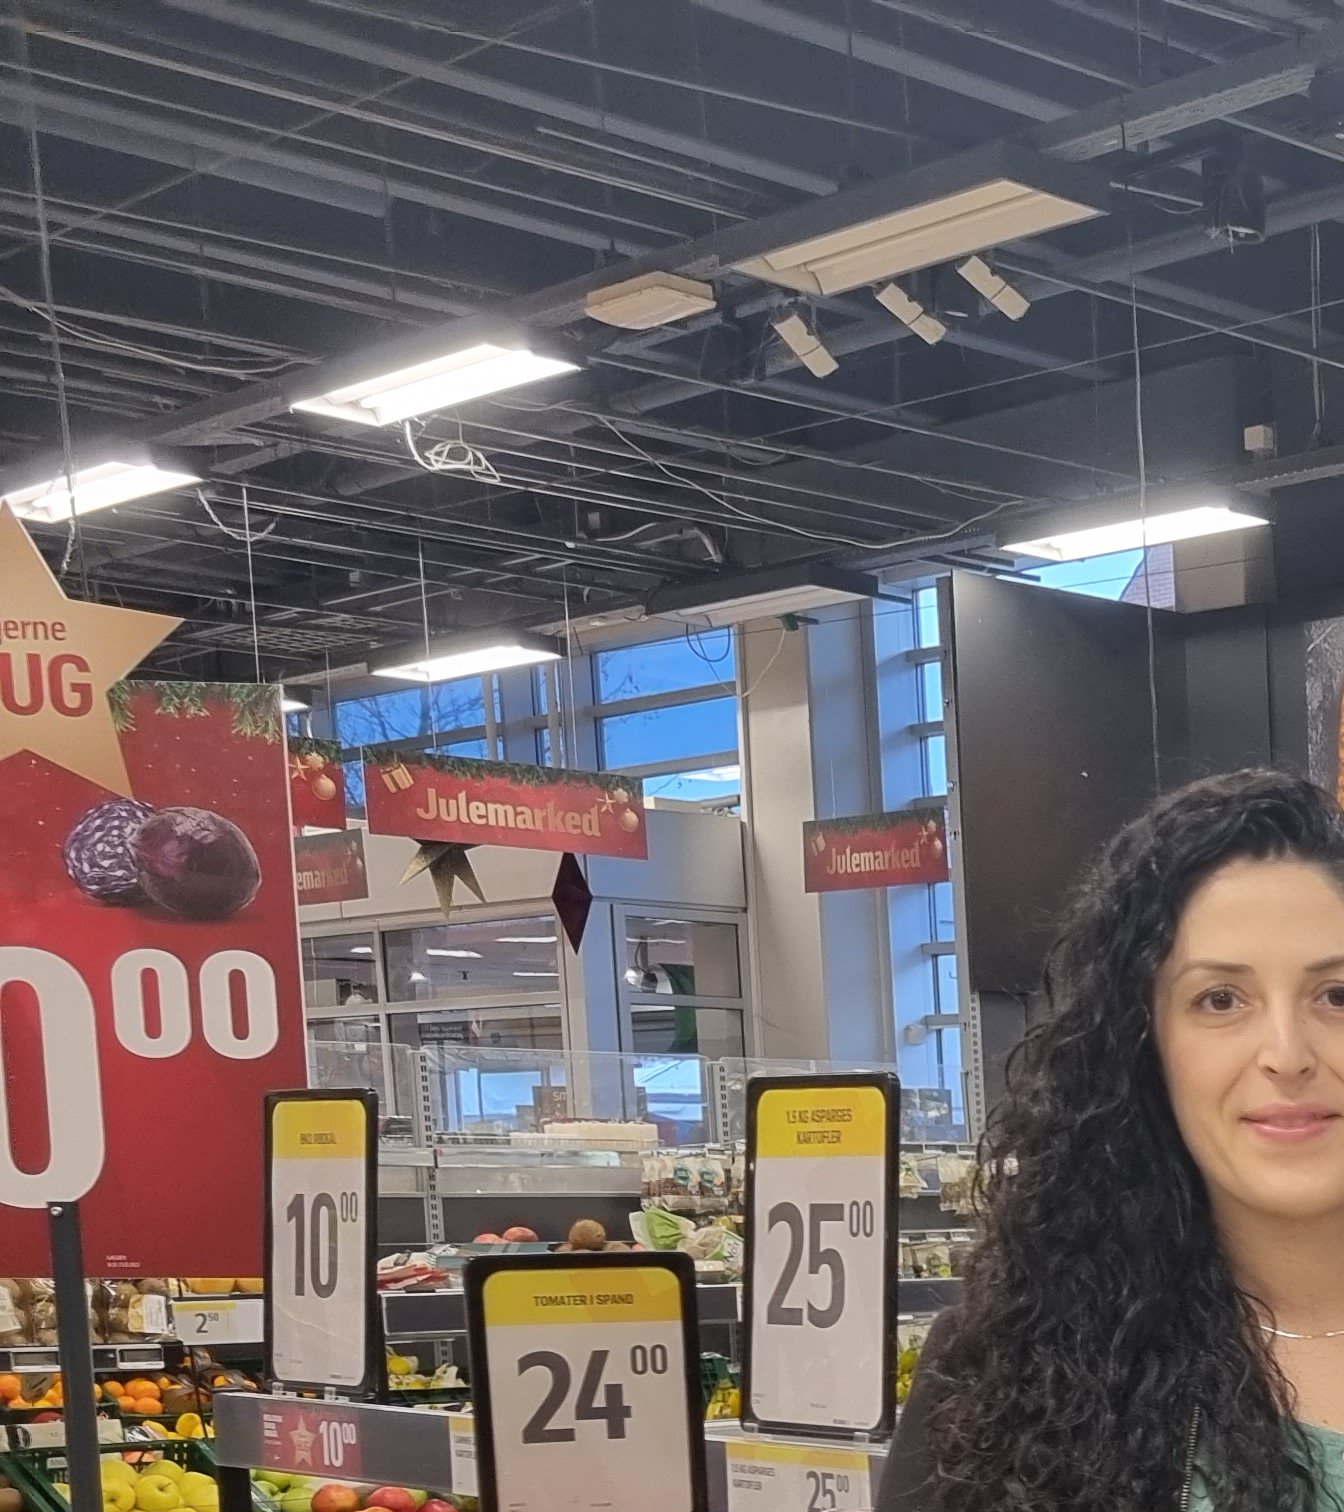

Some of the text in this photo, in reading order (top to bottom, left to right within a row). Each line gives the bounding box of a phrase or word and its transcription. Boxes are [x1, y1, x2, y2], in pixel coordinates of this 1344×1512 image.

[415, 787, 601, 838] Julemarked
[826, 840, 922, 875] Julemarked
[532, 1294, 588, 1307] TOMATER
[595, 1293, 635, 1305] SPAND
